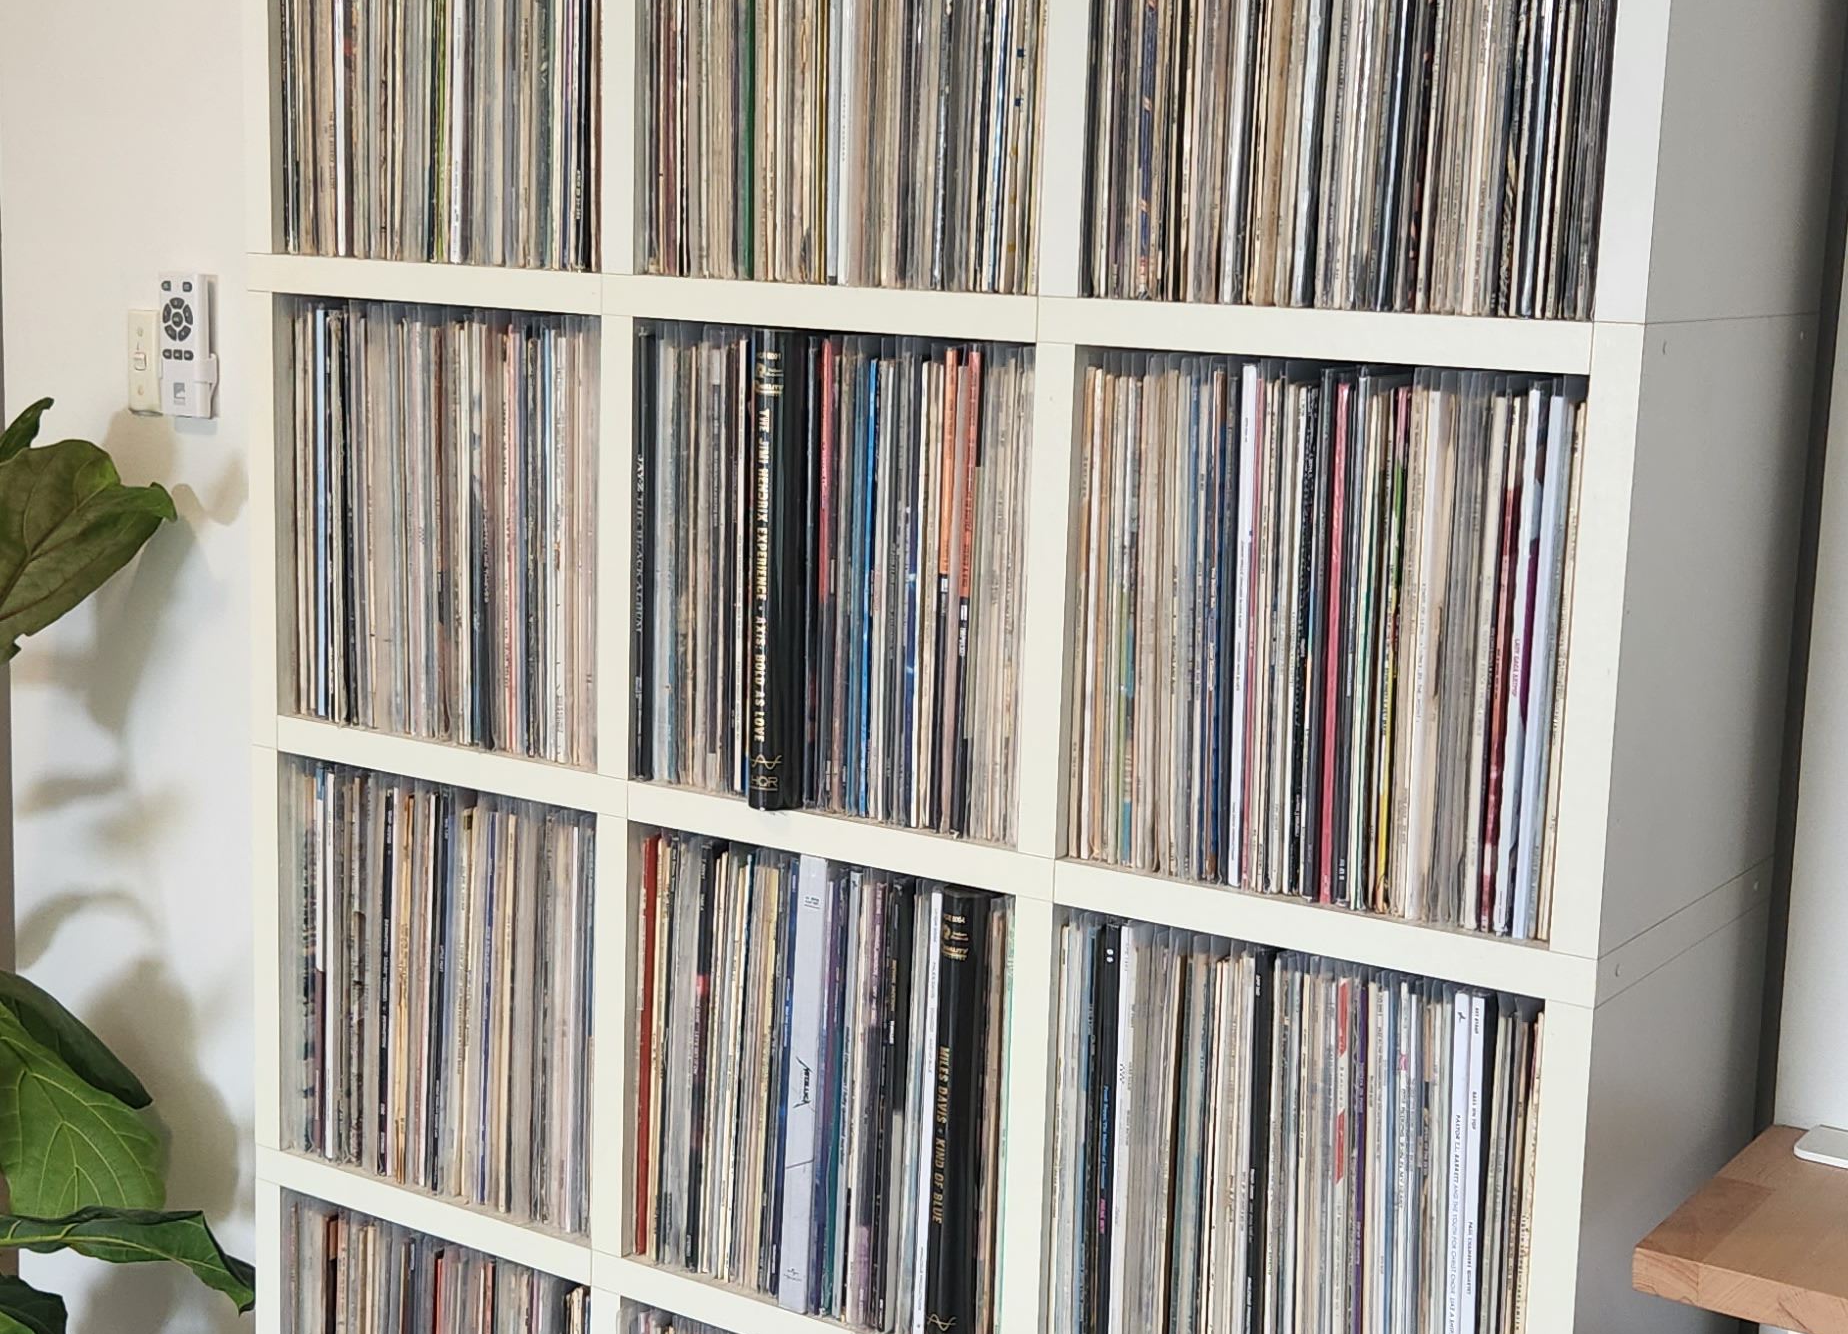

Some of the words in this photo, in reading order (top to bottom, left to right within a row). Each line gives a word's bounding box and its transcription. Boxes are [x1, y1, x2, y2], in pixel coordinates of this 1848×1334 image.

[758, 408, 770, 433] THE
[757, 437, 769, 464] JIMI
[636, 453, 645, 493] JAY-Z
[636, 494, 644, 526] THE
[756, 468, 769, 522] HENDRIX
[756, 526, 768, 601] EXPERIENCE
[754, 615, 767, 650] AXIS:
[754, 653, 766, 686] BOLD
[754, 690, 766, 707] AS
[753, 710, 765, 743] LOVE
[938, 1045, 951, 1083] MILES
[793, 1056, 814, 1109] METALLICA
[936, 1085, 949, 1125] DAVIS
[934, 1137, 946, 1169] KIND
[933, 1171, 945, 1189] OF
[932, 1191, 944, 1224] BLUE
